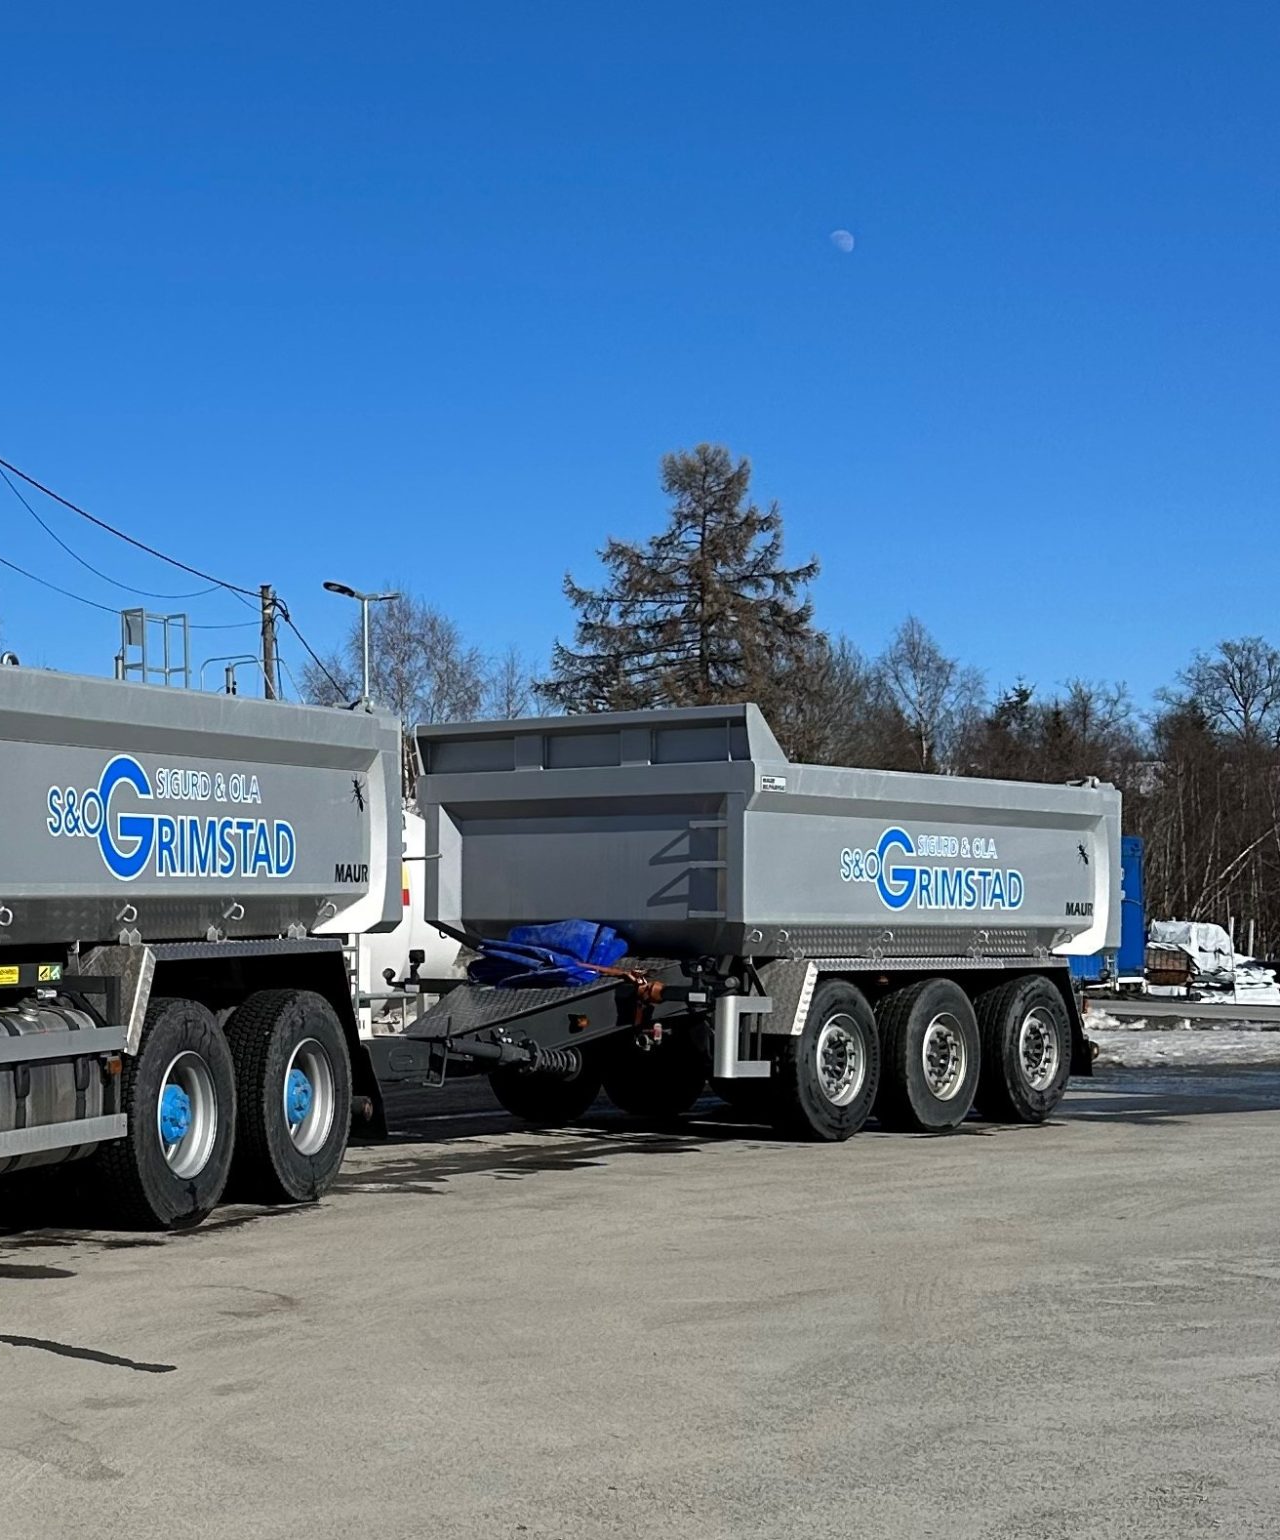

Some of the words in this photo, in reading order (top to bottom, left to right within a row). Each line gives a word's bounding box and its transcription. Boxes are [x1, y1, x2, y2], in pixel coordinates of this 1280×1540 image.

[155, 767, 212, 801] SIGURD
[214, 772, 228, 802] &
[228, 774, 262, 804] OLA
[47, 785, 104, 837] S&O
[97, 754, 297, 881] GRIMSTAD
[917, 834, 960, 858] SIGURD
[960, 836, 971, 858] &
[971, 837, 999, 860] OLA
[334, 863, 369, 883] MAUR
[875, 826, 1025, 911] GRIMSTAD
[1065, 902, 1094, 916] MAUR
